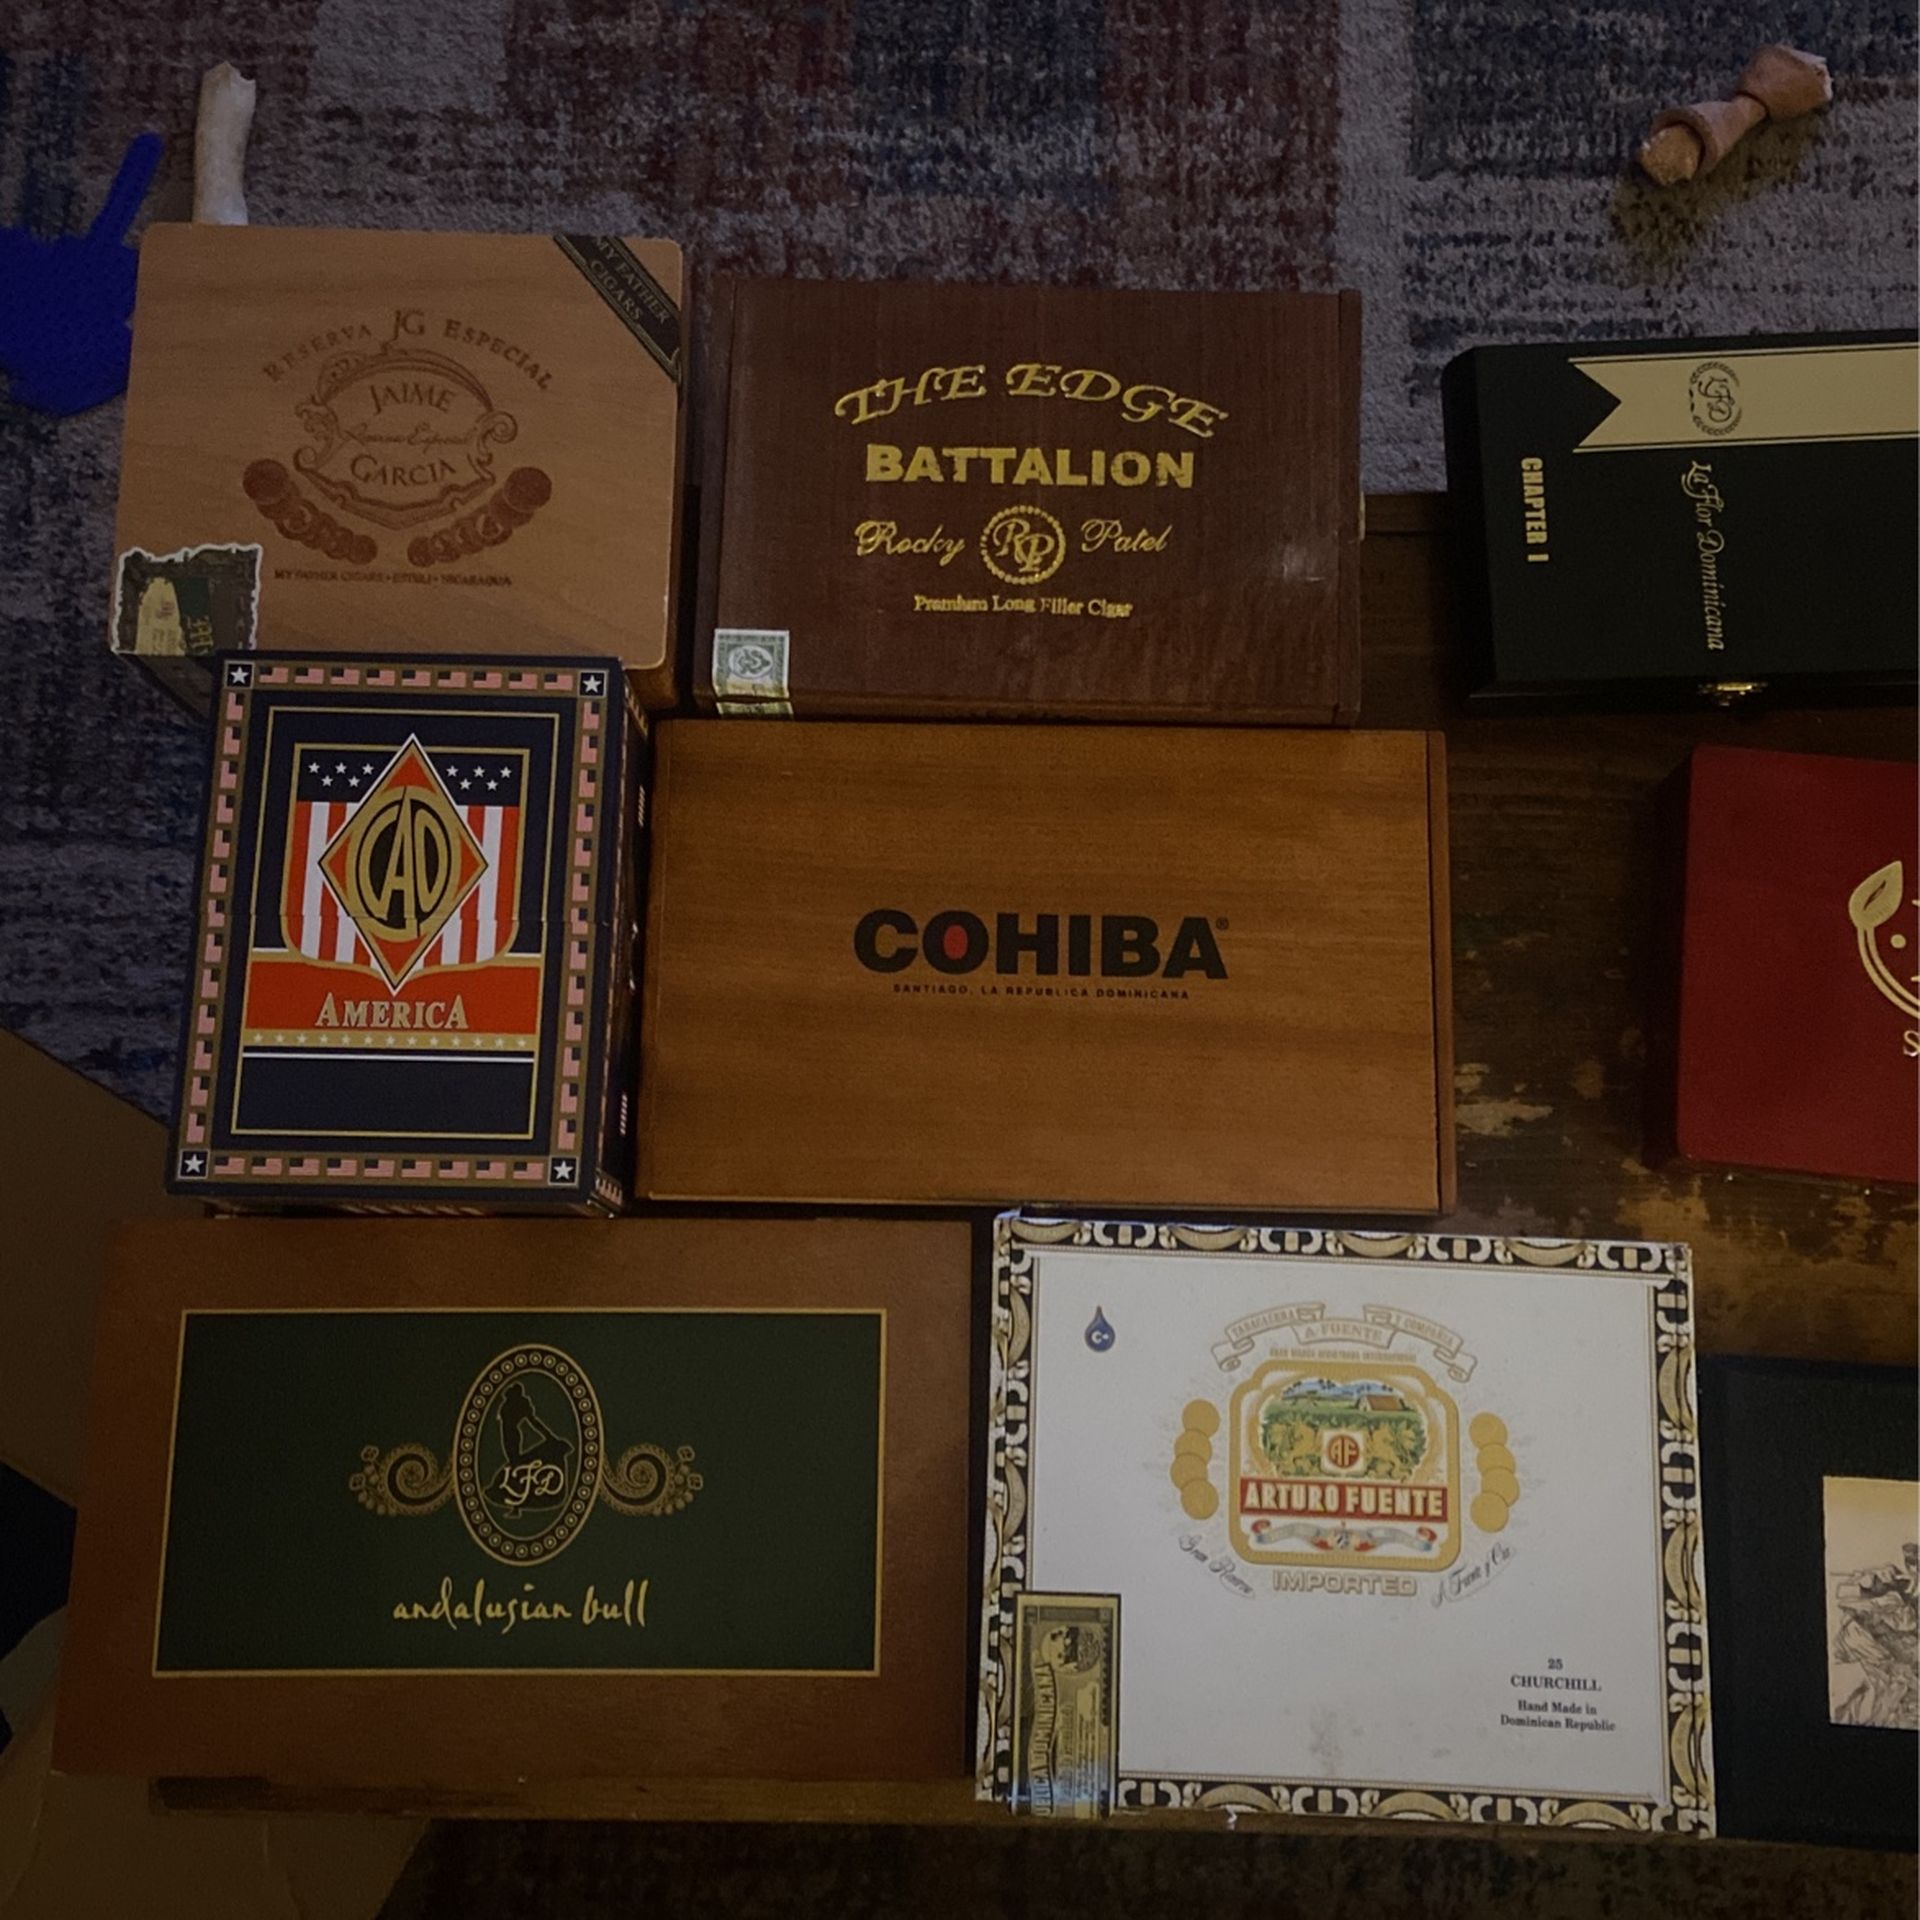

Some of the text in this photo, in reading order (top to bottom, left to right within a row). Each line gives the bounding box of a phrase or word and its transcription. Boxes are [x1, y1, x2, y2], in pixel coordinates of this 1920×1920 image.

[590, 260, 643, 321] CIGARS
[615, 263, 670, 325] FATHER
[263, 323, 372, 383] RESERVA
[442, 318, 553, 391] ESPECIAL
[371, 383, 456, 415] JAIME
[834, 361, 1229, 438] THE EDGE
[350, 453, 456, 486] GARCIA
[865, 443, 1196, 489] BATTALION
[1520, 456, 1550, 546] CHAPTER
[854, 519, 967, 567] Rocky
[1080, 517, 1173, 555] Patel
[1680, 460, 1726, 652] La Flor Dominicana
[913, 593, 1134, 619] Premium Long Filler Cigar
[314, 991, 469, 1031] AMERICA
[981, 985, 998, 996] LA
[1006, 986, 1089, 999] REPUBLICA
[1096, 988, 1190, 1000] DOMINICANA
[1320, 1323, 1383, 1342] FUENTE
[1243, 1480, 1445, 1518] ARTURO FUENTE
[1273, 1569, 1418, 1597] IMPORTED
[392, 1576, 651, 1635] andalusian bull
[1510, 1674, 1602, 1692] CHURCHILL
[1548, 1658, 1564, 1670] 25
[1500, 1714, 1617, 1733] Dominican Republic
[1517, 1699, 1598, 1716] Hand Made in
